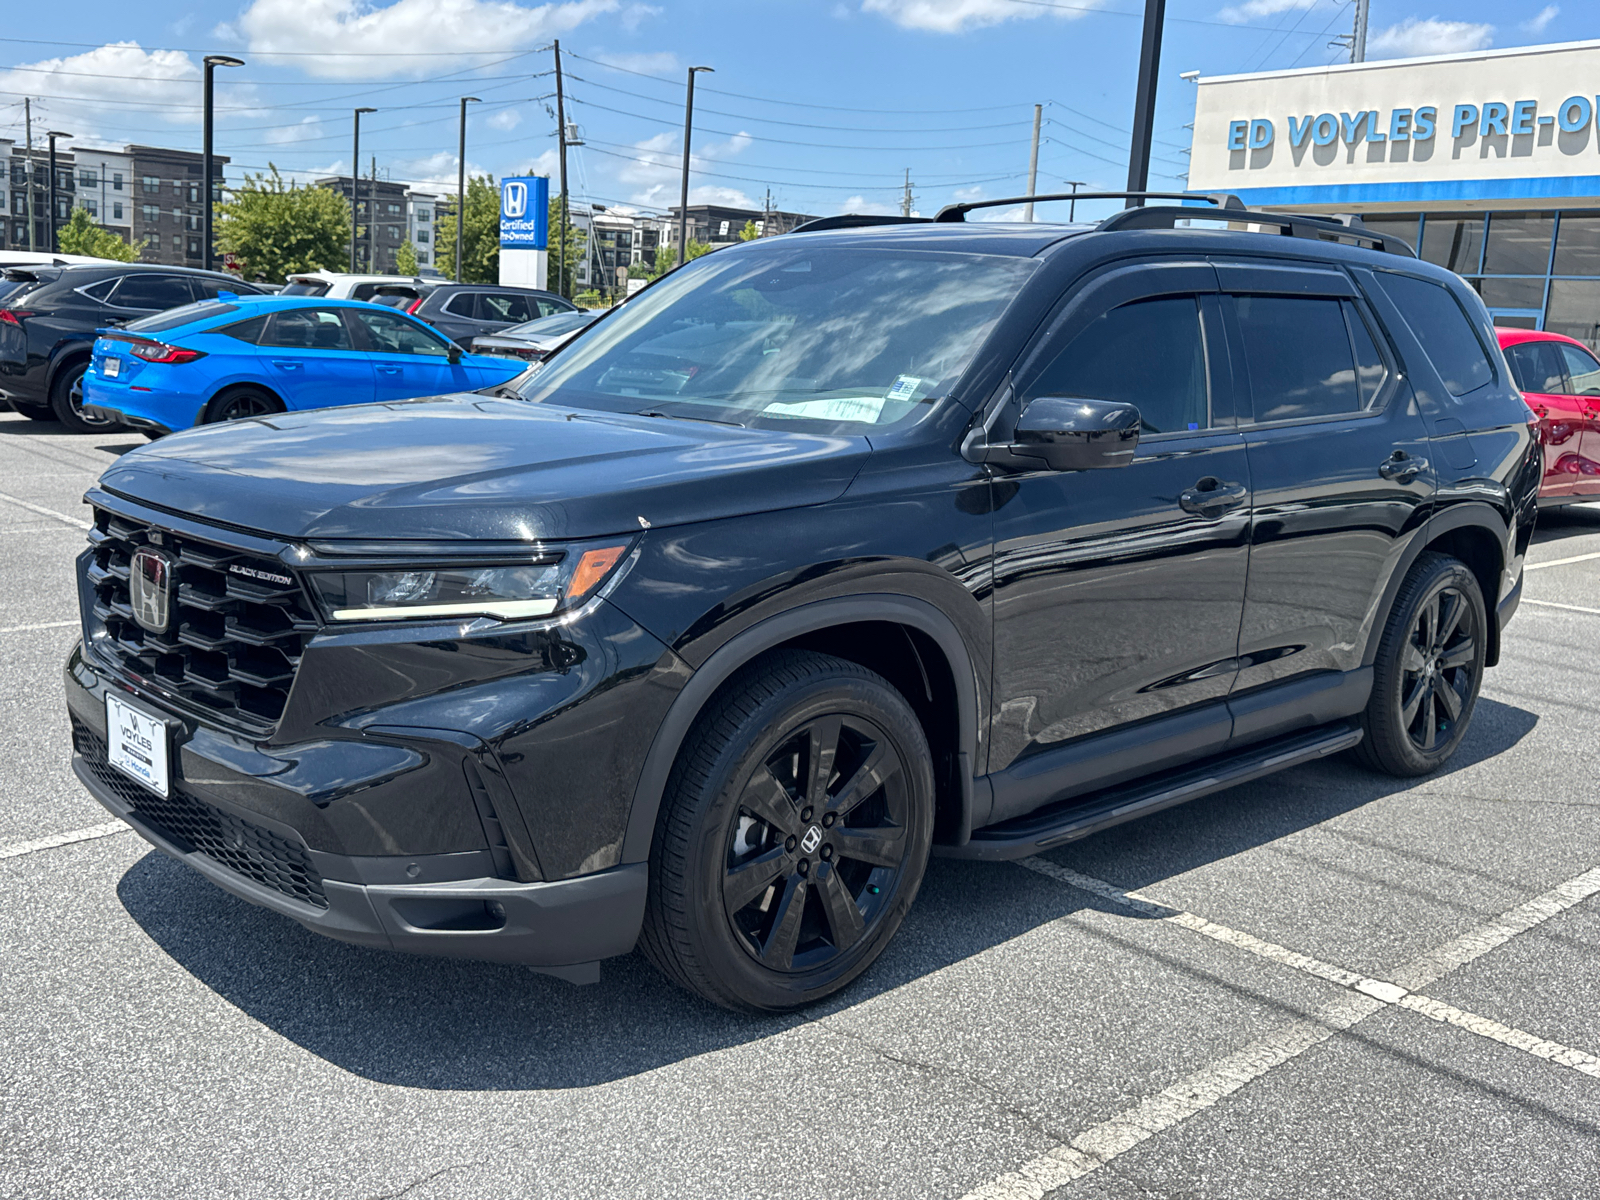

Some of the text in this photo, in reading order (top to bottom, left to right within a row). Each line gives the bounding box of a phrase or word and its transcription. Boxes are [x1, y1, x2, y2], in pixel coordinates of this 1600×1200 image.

[1228, 95, 1600, 150] ED VOYLES PRE-O
[500, 220, 534, 230] Certified
[500, 231, 534, 241] Pre-Owned
[229, 564, 292, 585] BLACK EDITION
[120, 724, 152, 751] VOYLES
